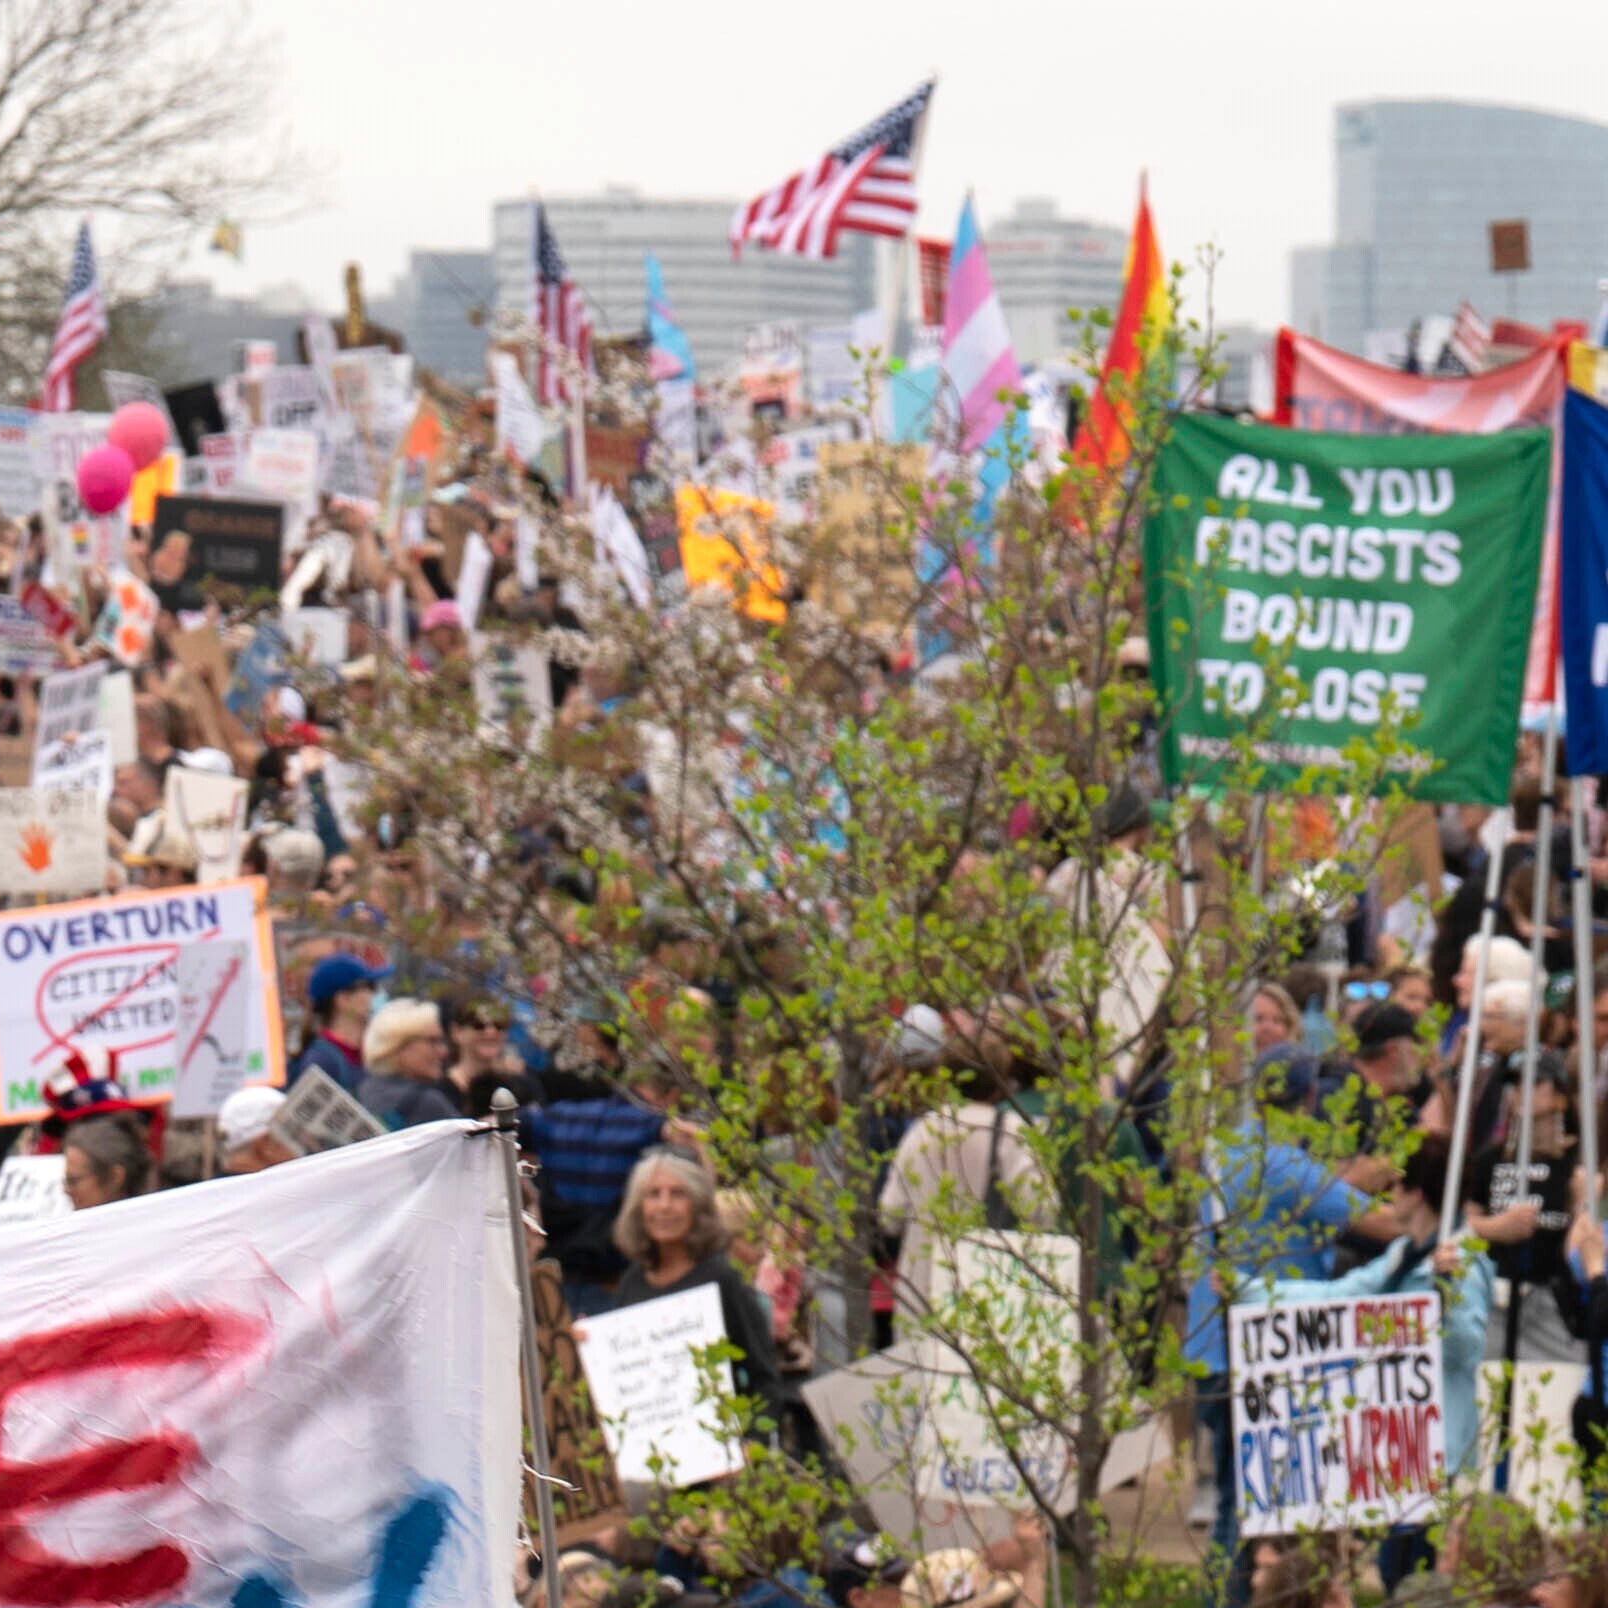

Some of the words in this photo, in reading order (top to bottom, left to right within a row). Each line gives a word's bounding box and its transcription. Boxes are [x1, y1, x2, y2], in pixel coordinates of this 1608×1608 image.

[1218, 454, 1323, 509] ALL
[1342, 468, 1454, 516] YOU
[1195, 516, 1461, 586] FASCISTS
[1221, 587, 1413, 653] BOUND
[1197, 658, 1265, 713] TO
[3, 895, 222, 962] OVERTURN
[1296, 1306, 1347, 1355] NOT
[1354, 1299, 1430, 1347] RIGHT
[1243, 1373, 1279, 1422] OR
[1240, 1420, 1323, 1513] RIGHT
